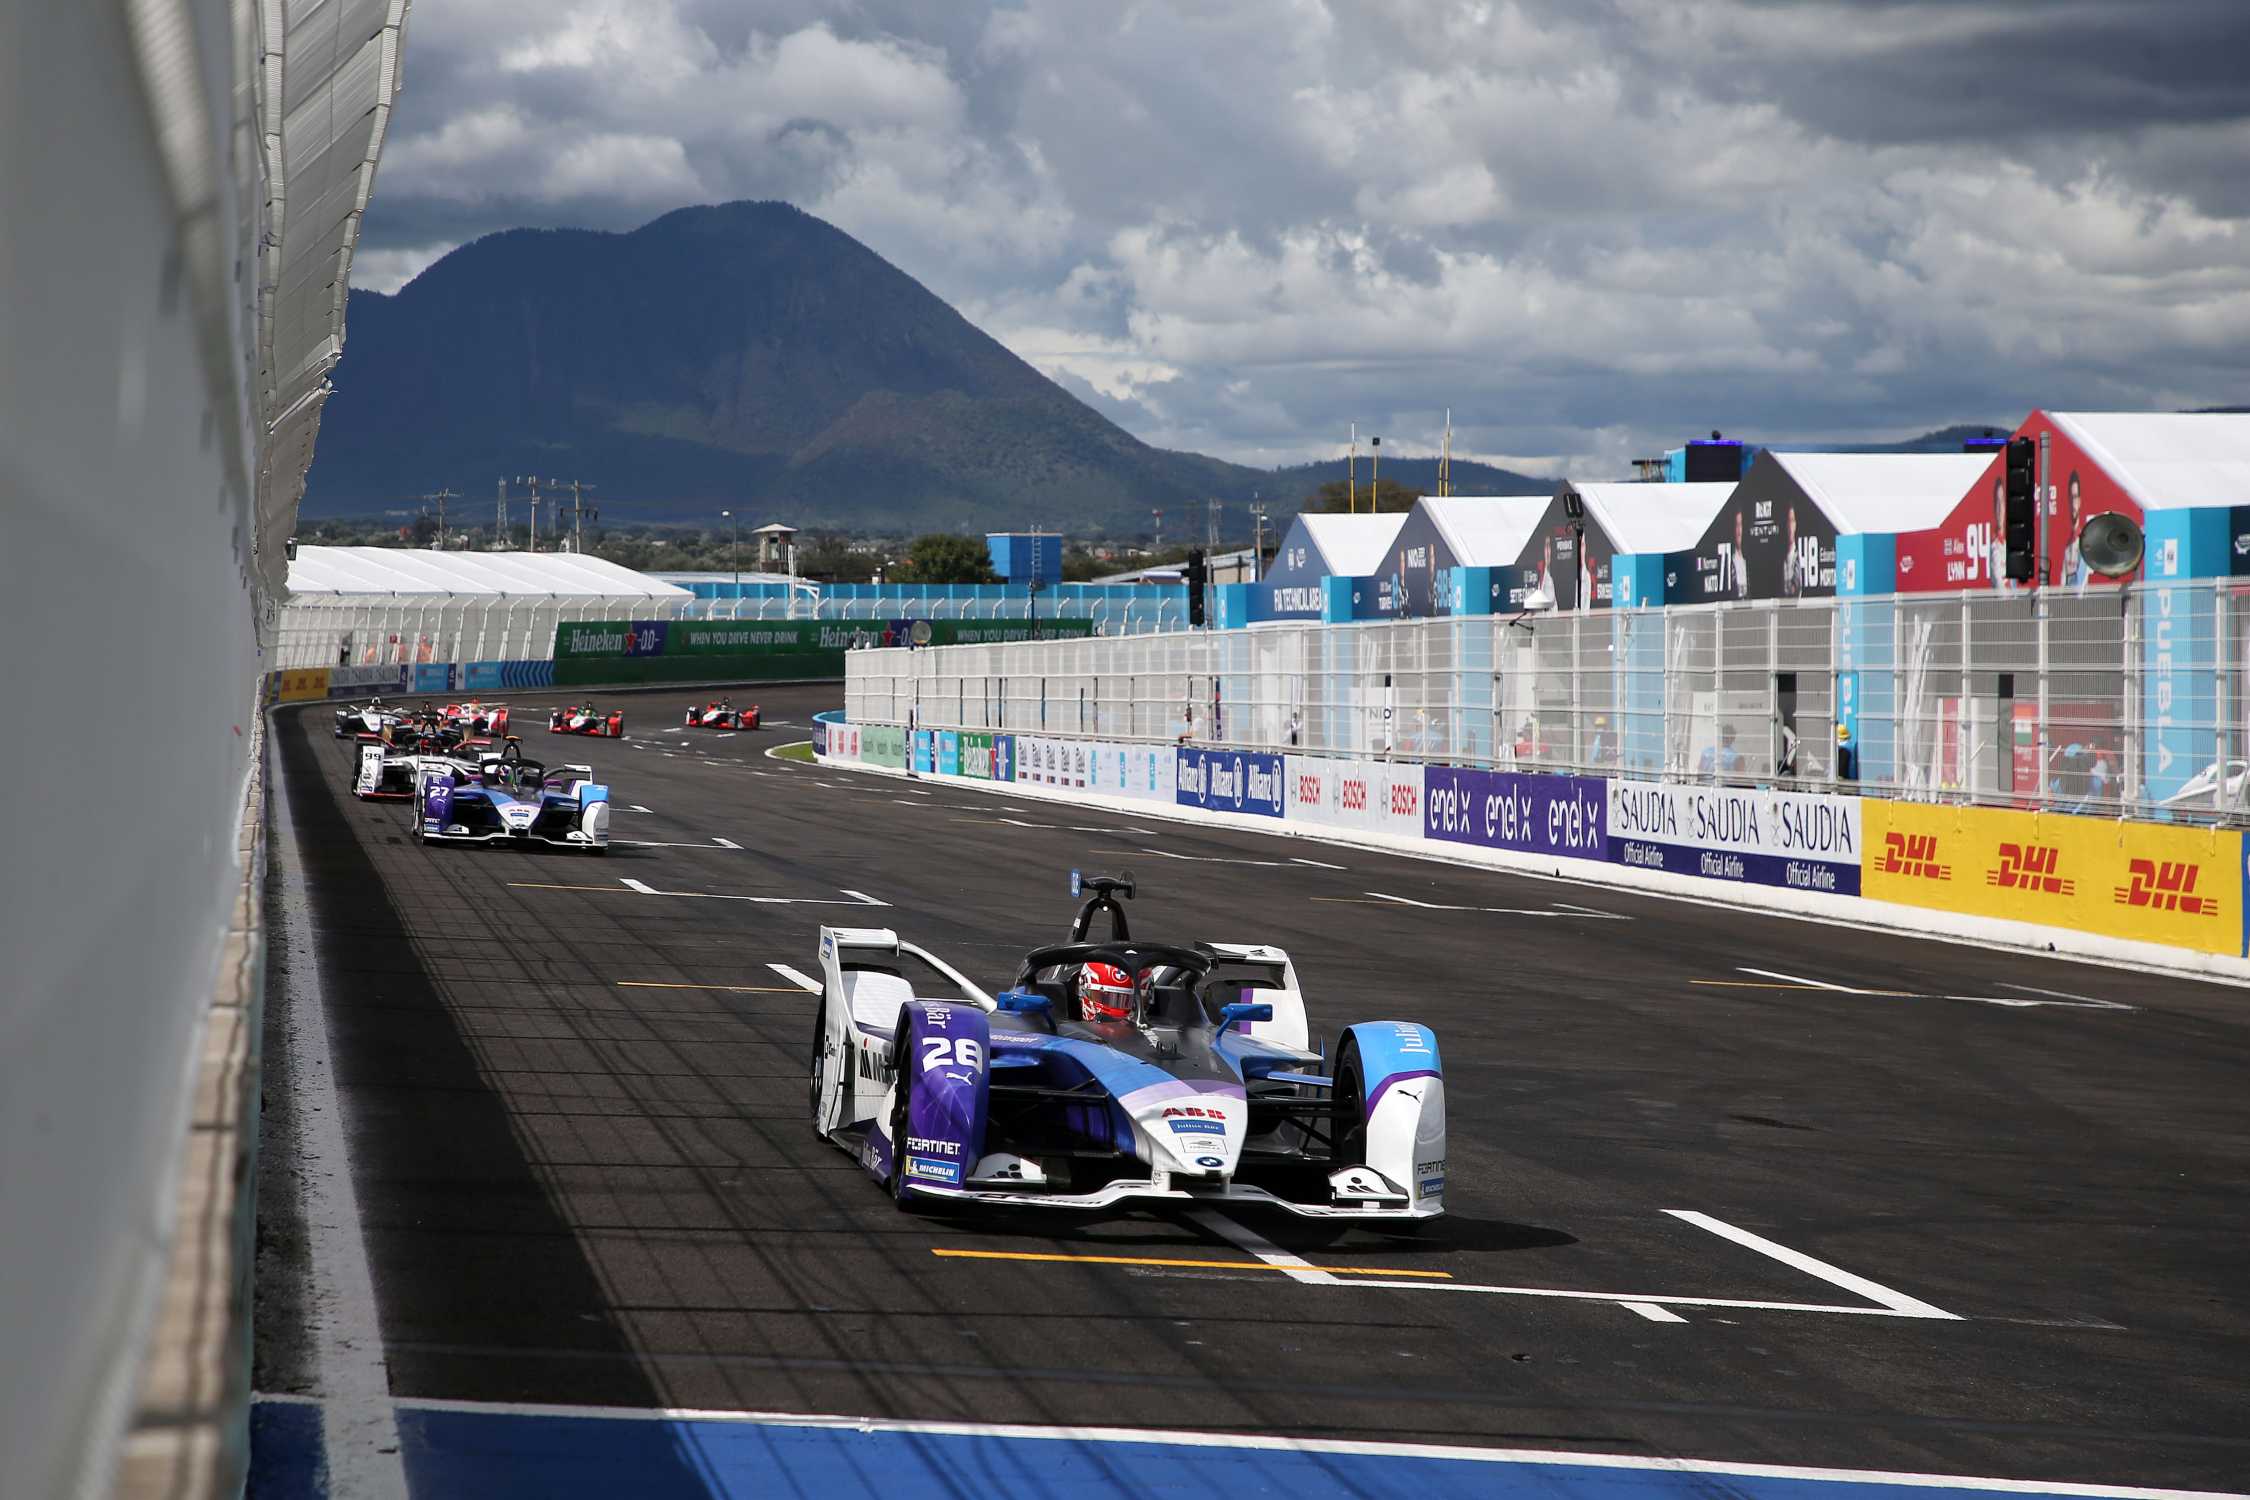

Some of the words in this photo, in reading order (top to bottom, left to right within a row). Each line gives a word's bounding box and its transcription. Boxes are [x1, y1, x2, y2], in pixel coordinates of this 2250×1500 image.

[1750, 525, 1779, 536] VENTURI
[1717, 542, 1732, 591] 71
[1798, 536, 1819, 587] 48
[1967, 522, 1991, 580] 94
[1947, 560, 1965, 582] LYNN
[570, 629, 622, 652] Heineken
[690, 632, 710, 646] WHEN
[712, 631, 728, 645] YOU
[729, 631, 748, 645] DRIVE
[751, 631, 772, 644] NEVER
[774, 631, 798, 644] DRINK
[957, 630, 981, 641] WHEN
[983, 629, 1001, 641] YOU
[1004, 629, 1027, 641] DRIVE
[1842, 600, 1852, 728] PUEBL
[2157, 588, 2172, 772] PUEBLA
[430, 786, 450, 798] 27
[1178, 758, 1198, 792] Allianz
[1211, 762, 1232, 797] Allianz
[1248, 764, 1271, 801] Allianz
[1300, 776, 1321, 805] BOSCH
[1343, 780, 1366, 810] BOSCH
[1392, 784, 1416, 816] BOSCH
[1430, 777, 1457, 832] enel
[1461, 790, 1470, 834] x
[1485, 783, 1518, 841] enel
[1521, 796, 1531, 841] x
[1621, 788, 1677, 836] SAUDIA
[1548, 787, 1583, 848] enel
[1587, 801, 1598, 849] x
[1697, 795, 1760, 844] SAUDIA
[1782, 801, 1852, 853] SAUDIA
[1624, 843, 1643, 865] Official
[1643, 846, 1663, 868] Airline
[1701, 853, 1723, 876] Official
[1723, 856, 1744, 879] Airline
[1884, 832, 1941, 879] DHL
[1998, 843, 2063, 893] DHL
[1786, 862, 1811, 887] Official
[1812, 865, 1835, 890] Airline
[2128, 858, 2202, 914] DHL
[1162, 1107, 1226, 1120] ABB
[906, 1137, 960, 1155] FORTINET
[919, 1165, 954, 1177] MICHELIN
